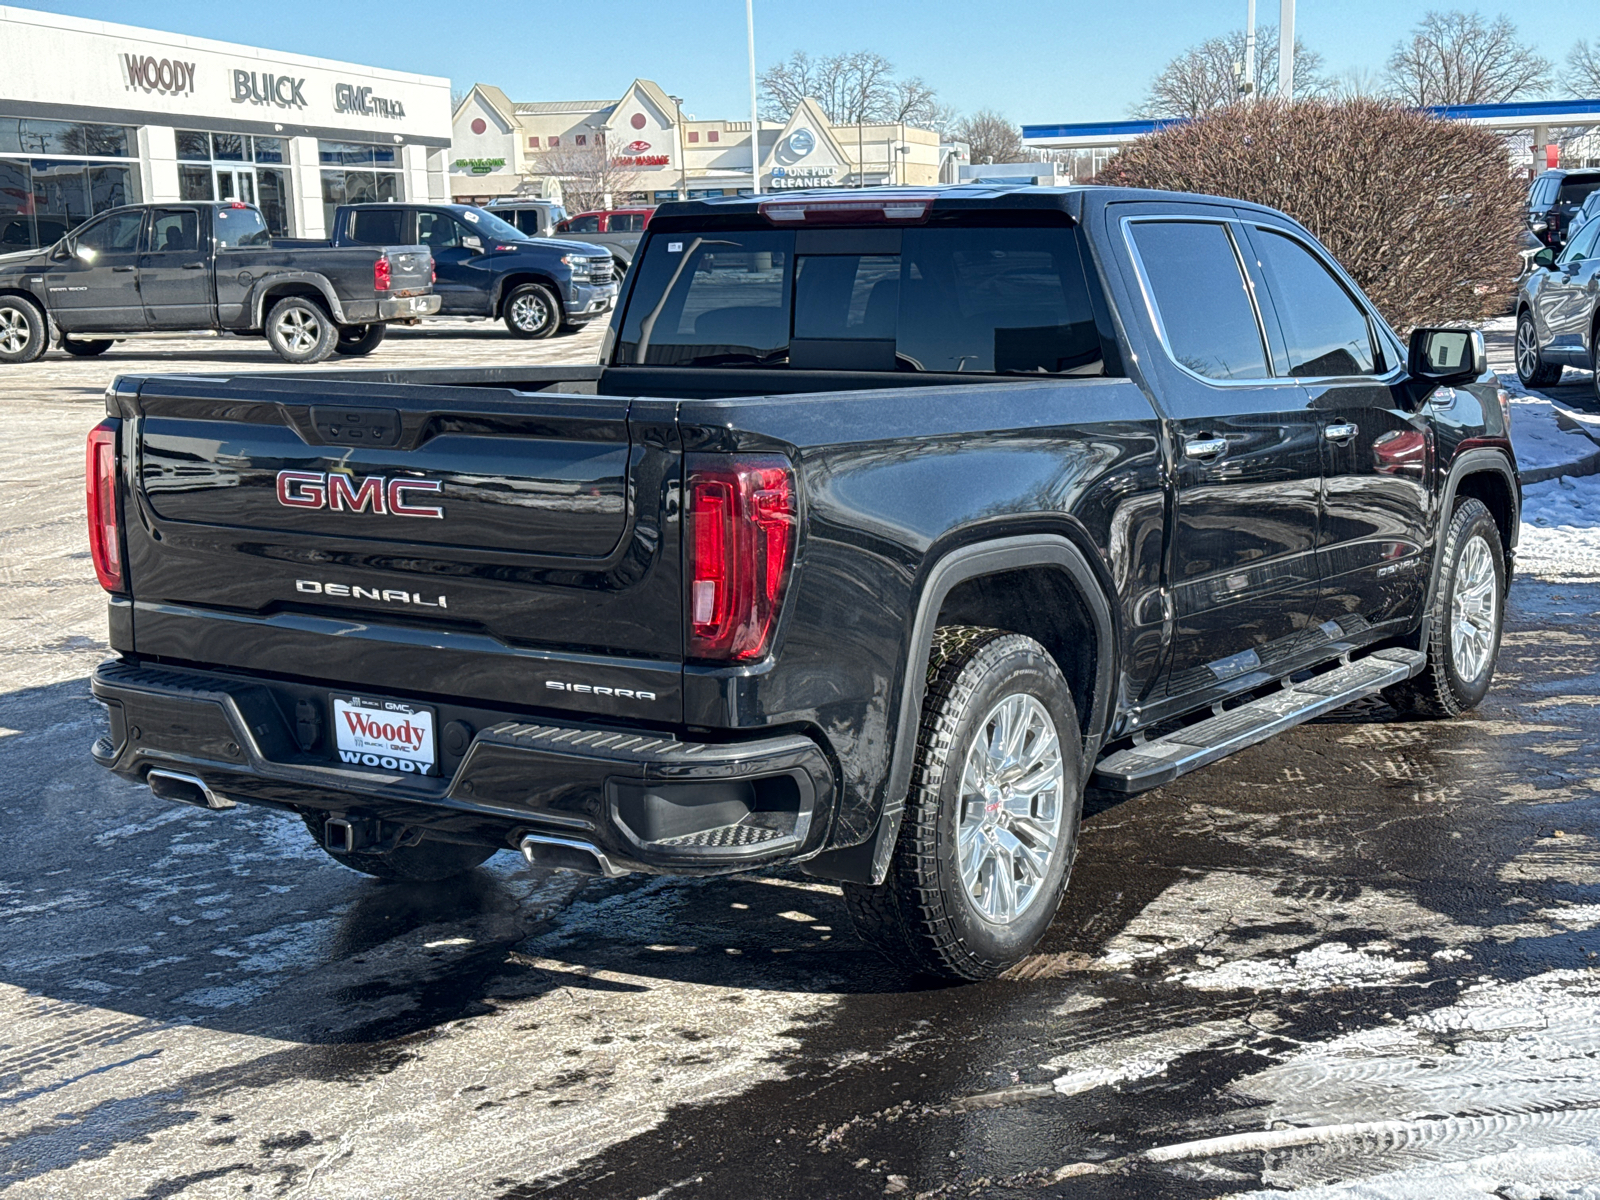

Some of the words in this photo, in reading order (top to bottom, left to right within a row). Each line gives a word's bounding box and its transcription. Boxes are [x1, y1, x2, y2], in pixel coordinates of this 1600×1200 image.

[123, 52, 196, 93] WOODY
[233, 69, 308, 106] BUICK
[335, 82, 374, 113] GMC
[371, 96, 406, 117] TRUCK
[635, 155, 670, 166] MASSAGE
[788, 166, 810, 177] ONE
[811, 166, 839, 176] PRICE
[771, 177, 837, 188] CLEANERS
[275, 469, 446, 521] GMC
[1376, 557, 1421, 578] DENALI
[295, 578, 448, 610] DENALI
[545, 680, 657, 701] SIERRA
[384, 702, 410, 715] GMC
[341, 710, 426, 752] Woody
[390, 743, 411, 753] GMC
[338, 750, 432, 776] WOODY
